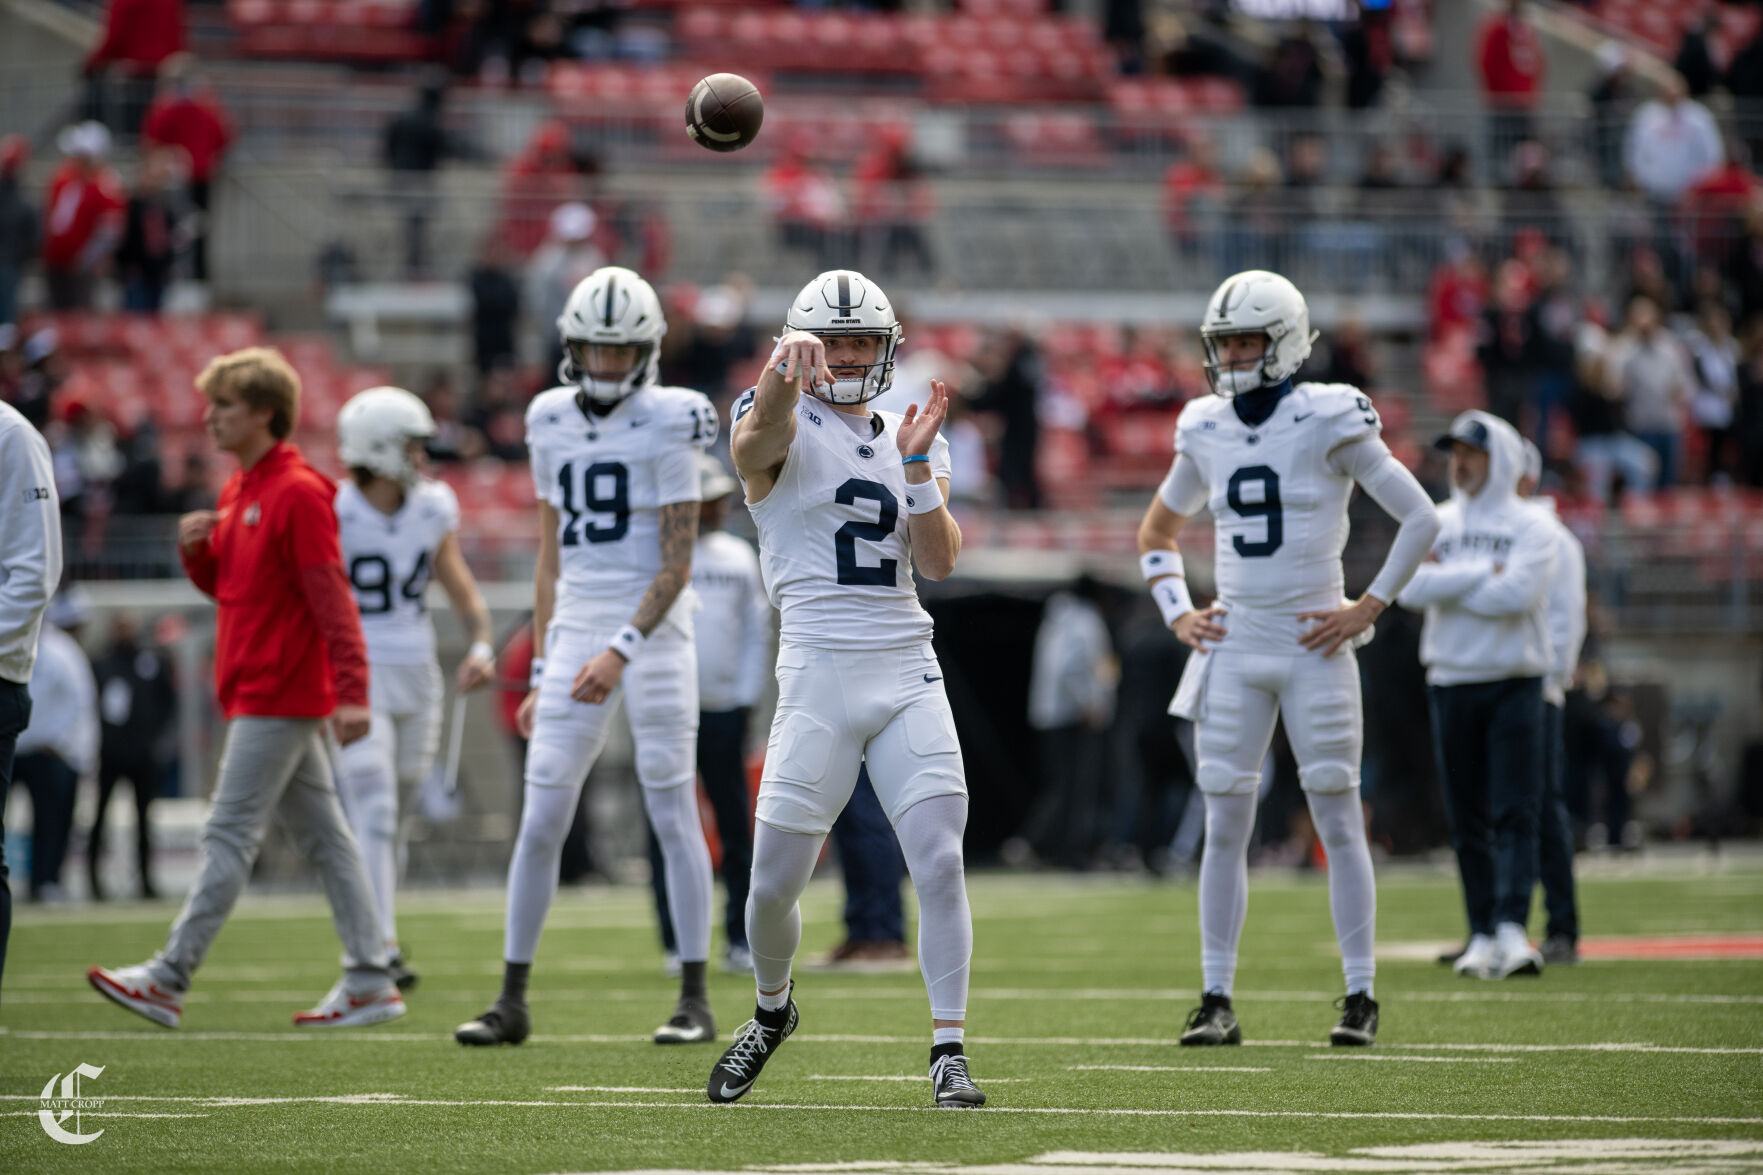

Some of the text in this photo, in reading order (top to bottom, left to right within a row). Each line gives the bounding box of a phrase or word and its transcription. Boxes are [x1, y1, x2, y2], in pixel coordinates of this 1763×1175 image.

[1356, 397, 1376, 425] 9
[558, 461, 629, 546] 19
[835, 478, 898, 587] 2
[1227, 465, 1282, 558] 9
[351, 551, 428, 613] 94
